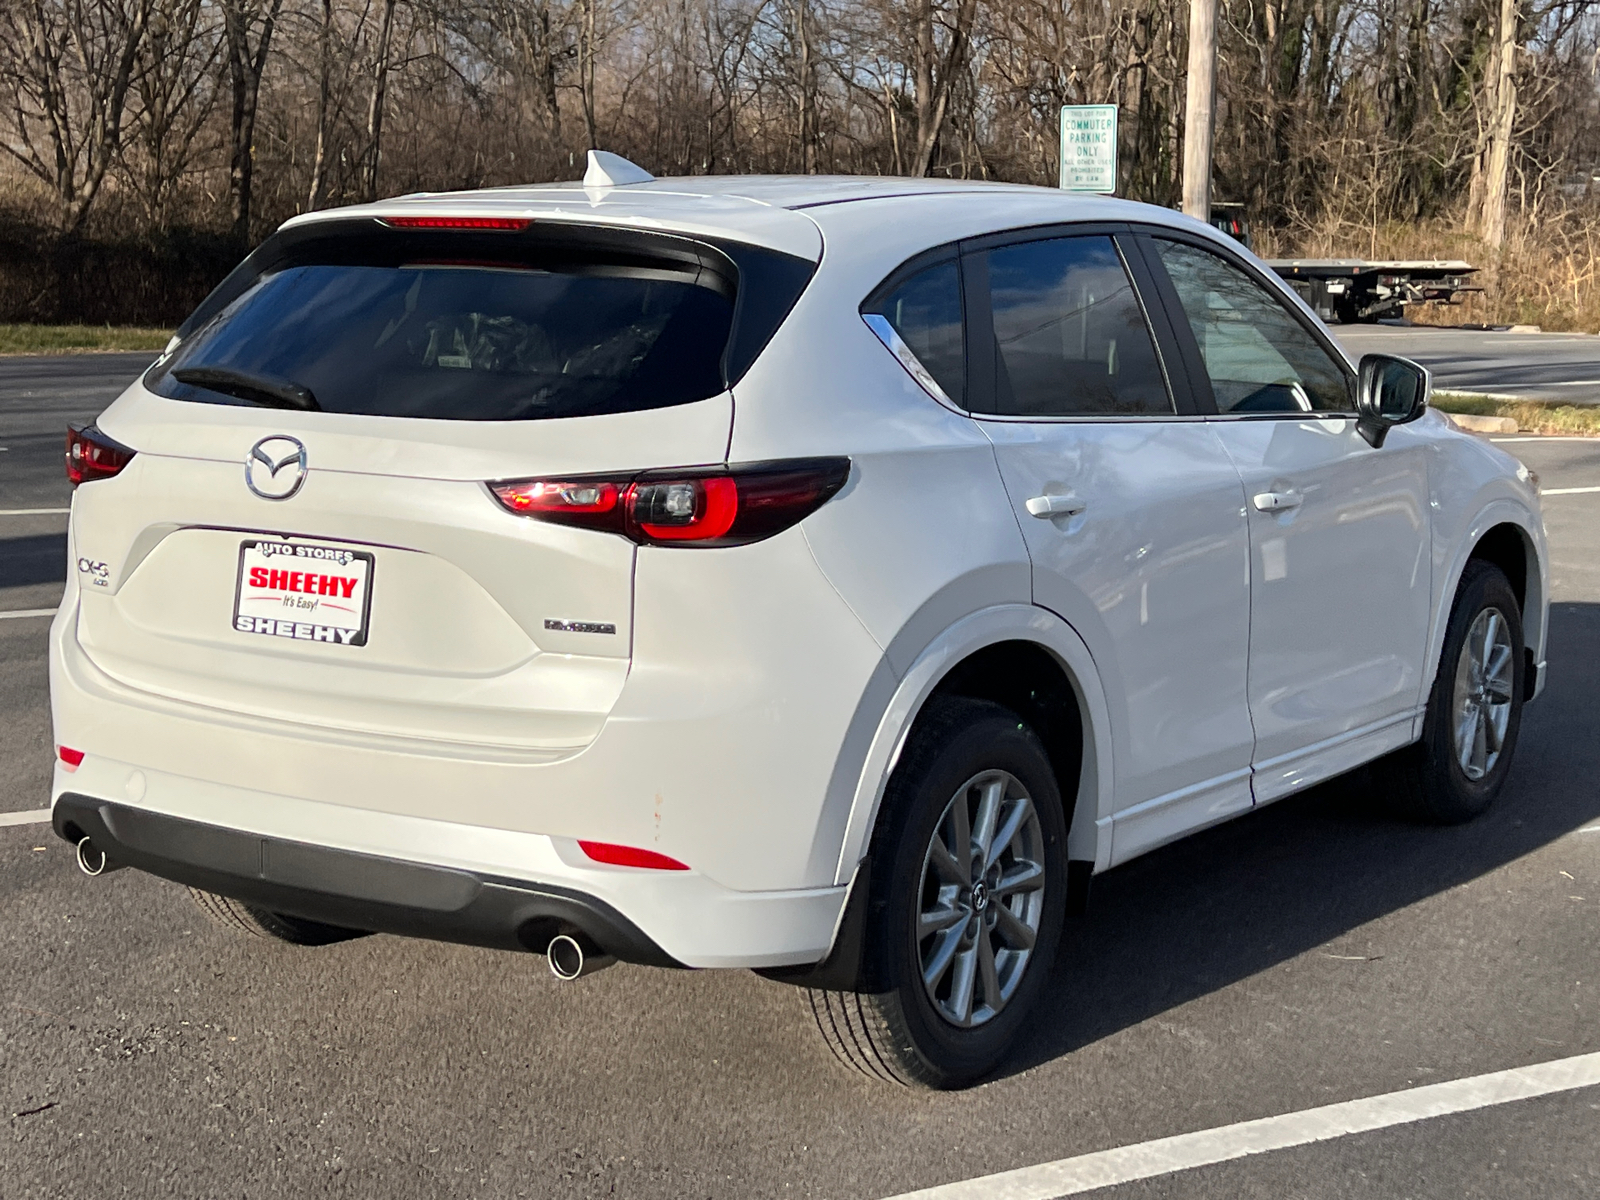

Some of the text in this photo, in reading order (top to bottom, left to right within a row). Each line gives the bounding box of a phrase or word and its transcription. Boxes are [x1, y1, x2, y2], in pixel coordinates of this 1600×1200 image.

[1065, 119, 1112, 130] COMMUTER
[1069, 133, 1107, 143] PARKING
[1076, 146, 1099, 157] ONLY
[255, 542, 354, 562] AUTO STORES
[249, 566, 359, 599] SHEEHY
[282, 595, 319, 612] It's Easy!
[236, 616, 358, 645] SHEEHY
